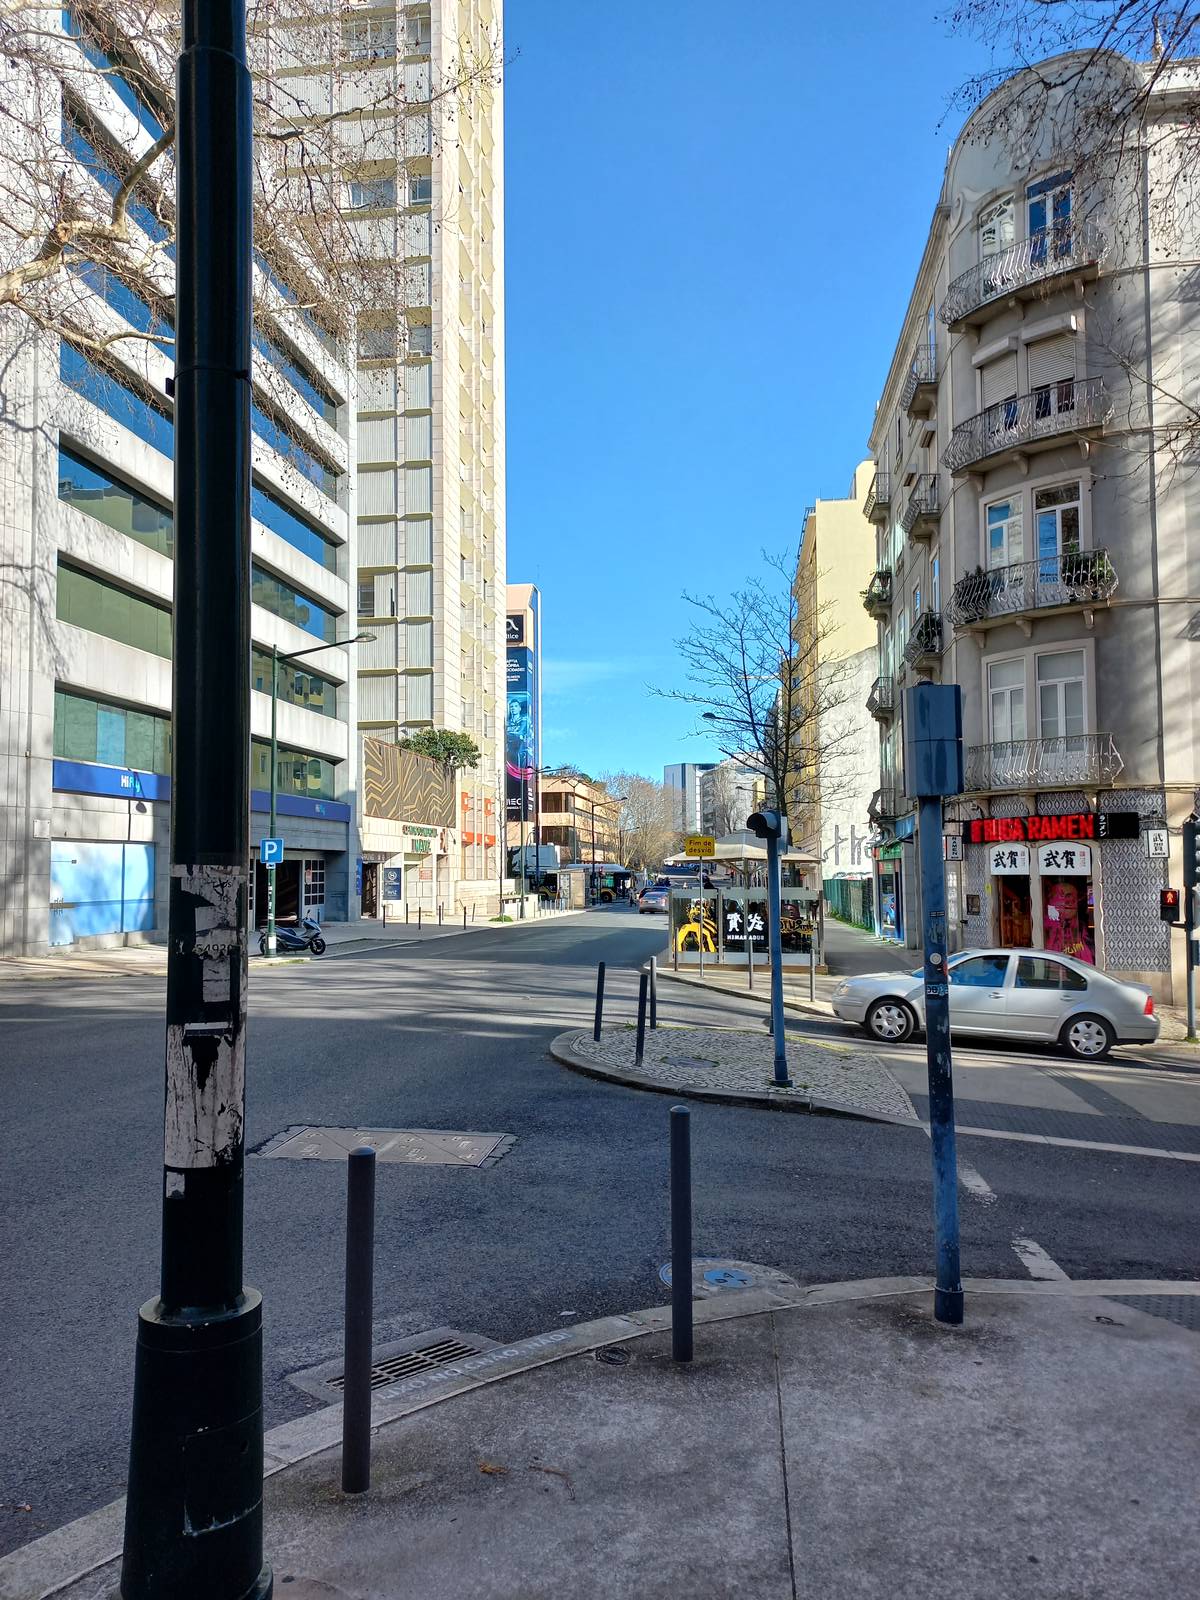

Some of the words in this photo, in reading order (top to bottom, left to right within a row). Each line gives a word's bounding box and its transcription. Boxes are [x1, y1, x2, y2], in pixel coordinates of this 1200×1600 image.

[1028, 814, 1094, 840] RAMEN
[264, 841, 278, 861] P
[428, 1368, 461, 1380] NO
